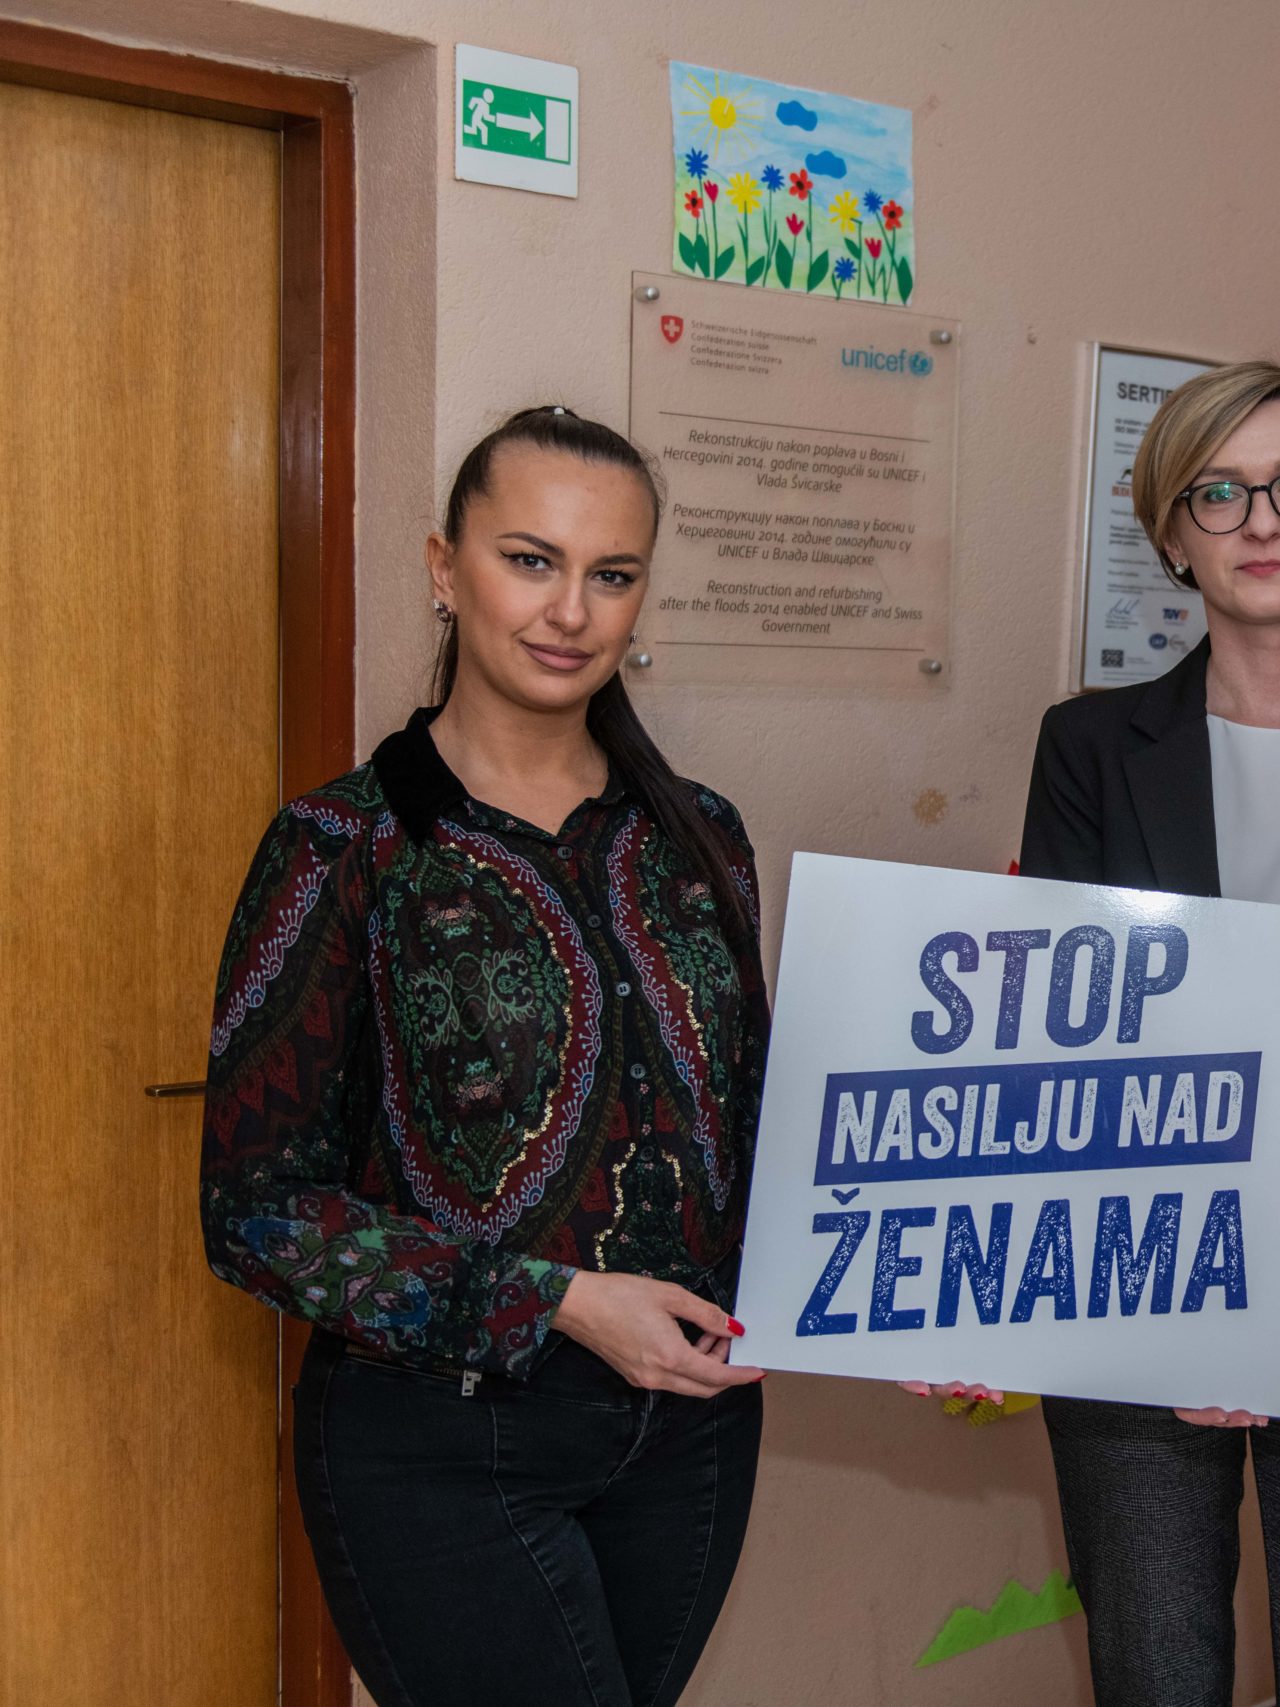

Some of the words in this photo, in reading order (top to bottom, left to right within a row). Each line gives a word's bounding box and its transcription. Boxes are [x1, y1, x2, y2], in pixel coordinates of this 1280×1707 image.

[841, 344, 907, 373] unicef
[689, 430, 773, 453] Rekonstrukciju
[777, 440, 811, 454] nakon
[813, 444, 857, 459] poplava
[860, 450, 867, 460] u
[869, 448, 899, 462] Bosni
[663, 446, 733, 465] Hercegovini
[770, 457, 809, 472] godine
[812, 462, 864, 478] omogućili
[867, 468, 880, 479] su
[882, 467, 920, 482] UNICEF
[756, 473, 788, 489] Vlada
[791, 473, 842, 493] Švicarske
[673, 503, 772, 525] Реконструкцију
[775, 513, 809, 526] након
[812, 516, 860, 530] поплава
[863, 521, 871, 533] у
[873, 518, 905, 533] Босни
[908, 524, 915, 534] и
[676, 523, 755, 540] Херцеговини
[791, 531, 832, 545] године
[835, 535, 897, 550] омогућили
[899, 540, 912, 553] су
[717, 544, 760, 559] UNICEF
[762, 549, 769, 560] и
[772, 547, 808, 561] Влада
[811, 549, 875, 567] Швицарске
[706, 580, 792, 597] Reconstruction
[794, 586, 815, 599] and
[819, 585, 882, 604] refurbishing
[659, 596, 687, 611] after
[691, 597, 710, 612] the
[714, 598, 749, 614] floods
[752, 604, 779, 618] 2014
[783, 602, 828, 617] enabled
[830, 604, 868, 618] UNICEF
[871, 606, 892, 620] and
[894, 607, 923, 620] Swiss
[761, 619, 831, 634] Government
[911, 924, 1189, 1055] STOP
[831, 1079, 1098, 1165] NASILJU
[1117, 1070, 1245, 1148] NAD
[796, 1187, 1249, 1337] ŽENAMA
